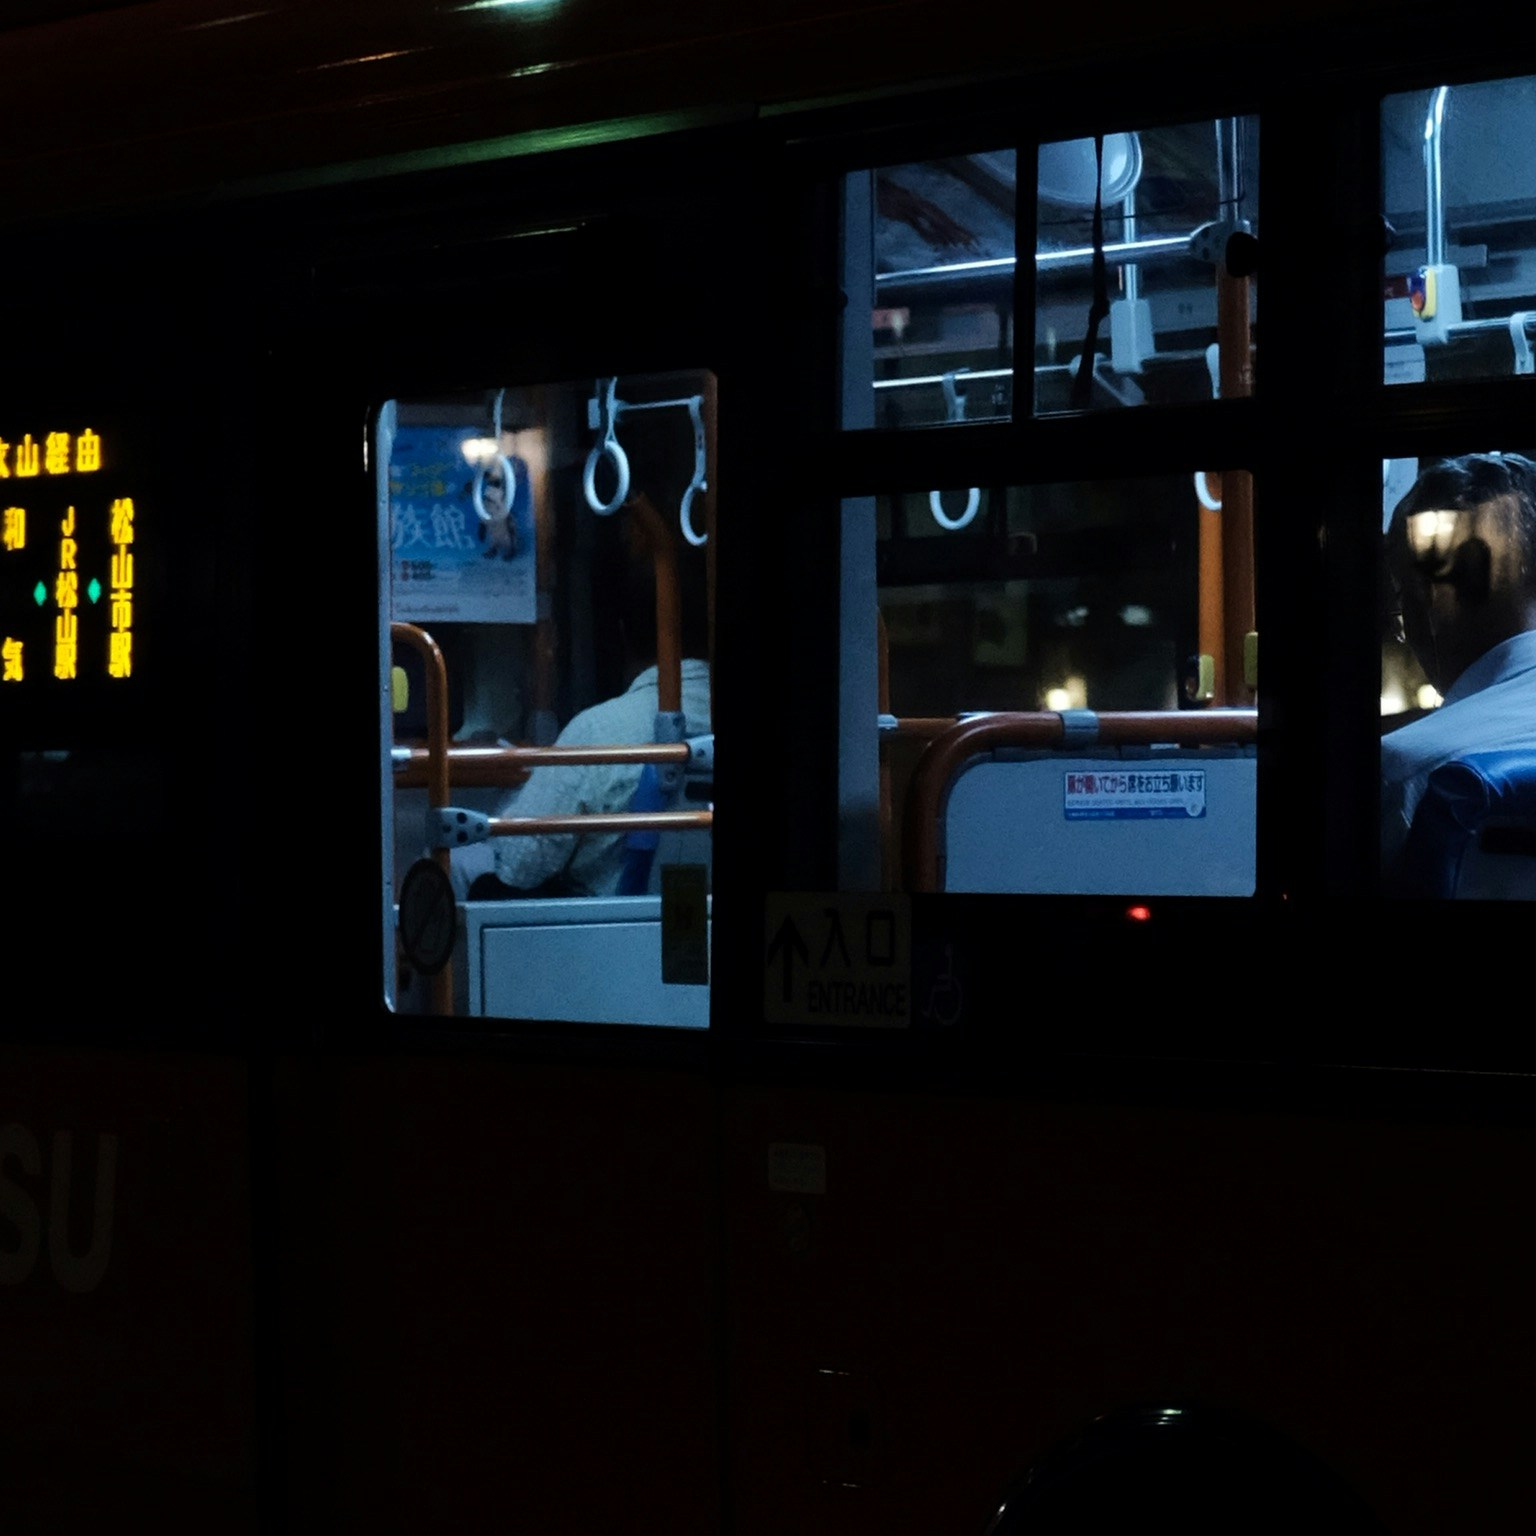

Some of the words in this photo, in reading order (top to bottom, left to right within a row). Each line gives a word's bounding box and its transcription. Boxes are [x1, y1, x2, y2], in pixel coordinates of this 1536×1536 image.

[54, 505, 78, 679] JR松山駅
[109, 497, 134, 678] 松山市駅
[808, 980, 906, 1016] ENTRANCE
[820, 907, 895, 967] 入口
[0, 1122, 119, 1293] SU
